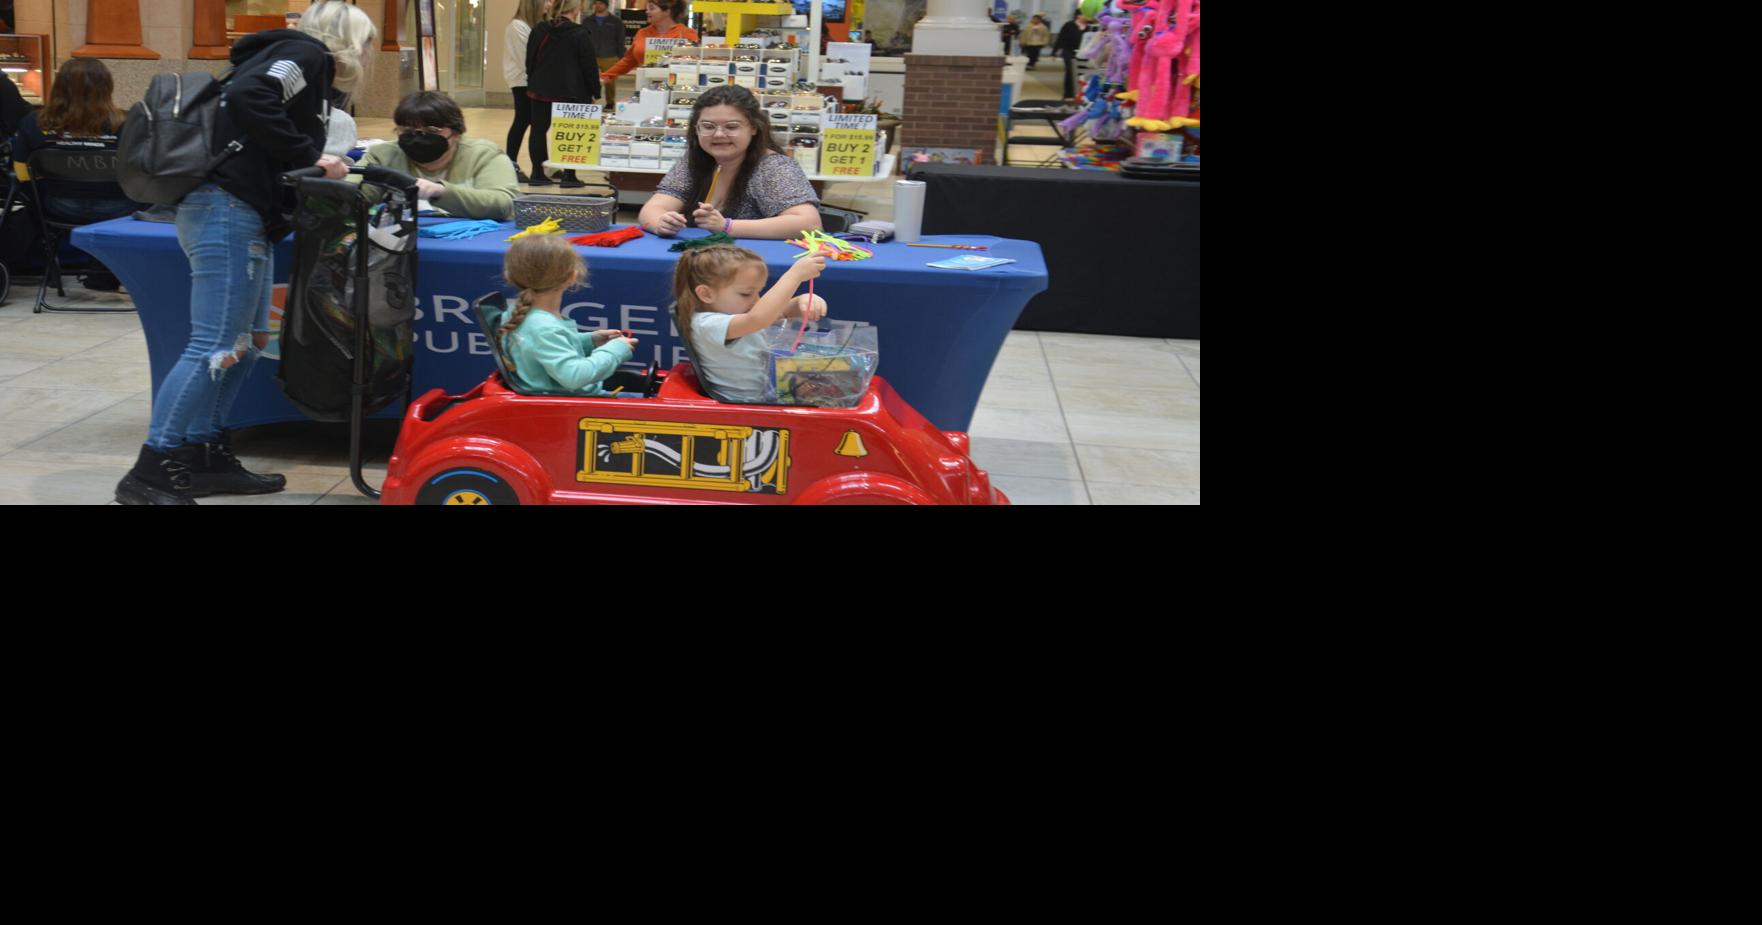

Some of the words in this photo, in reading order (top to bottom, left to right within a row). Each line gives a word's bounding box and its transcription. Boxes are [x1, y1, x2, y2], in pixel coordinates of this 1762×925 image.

[556, 104, 599, 112] LIMITED
[828, 114, 873, 122] LIMITED
[555, 131, 586, 141] BUY
[588, 133, 596, 142] 2
[557, 144, 583, 153] GET
[586, 145, 592, 153] 1
[826, 142, 859, 152] BUY
[862, 144, 870, 153] 2
[561, 154, 587, 163] FREE
[829, 155, 857, 164] GET
[832, 166, 861, 175] FREE
